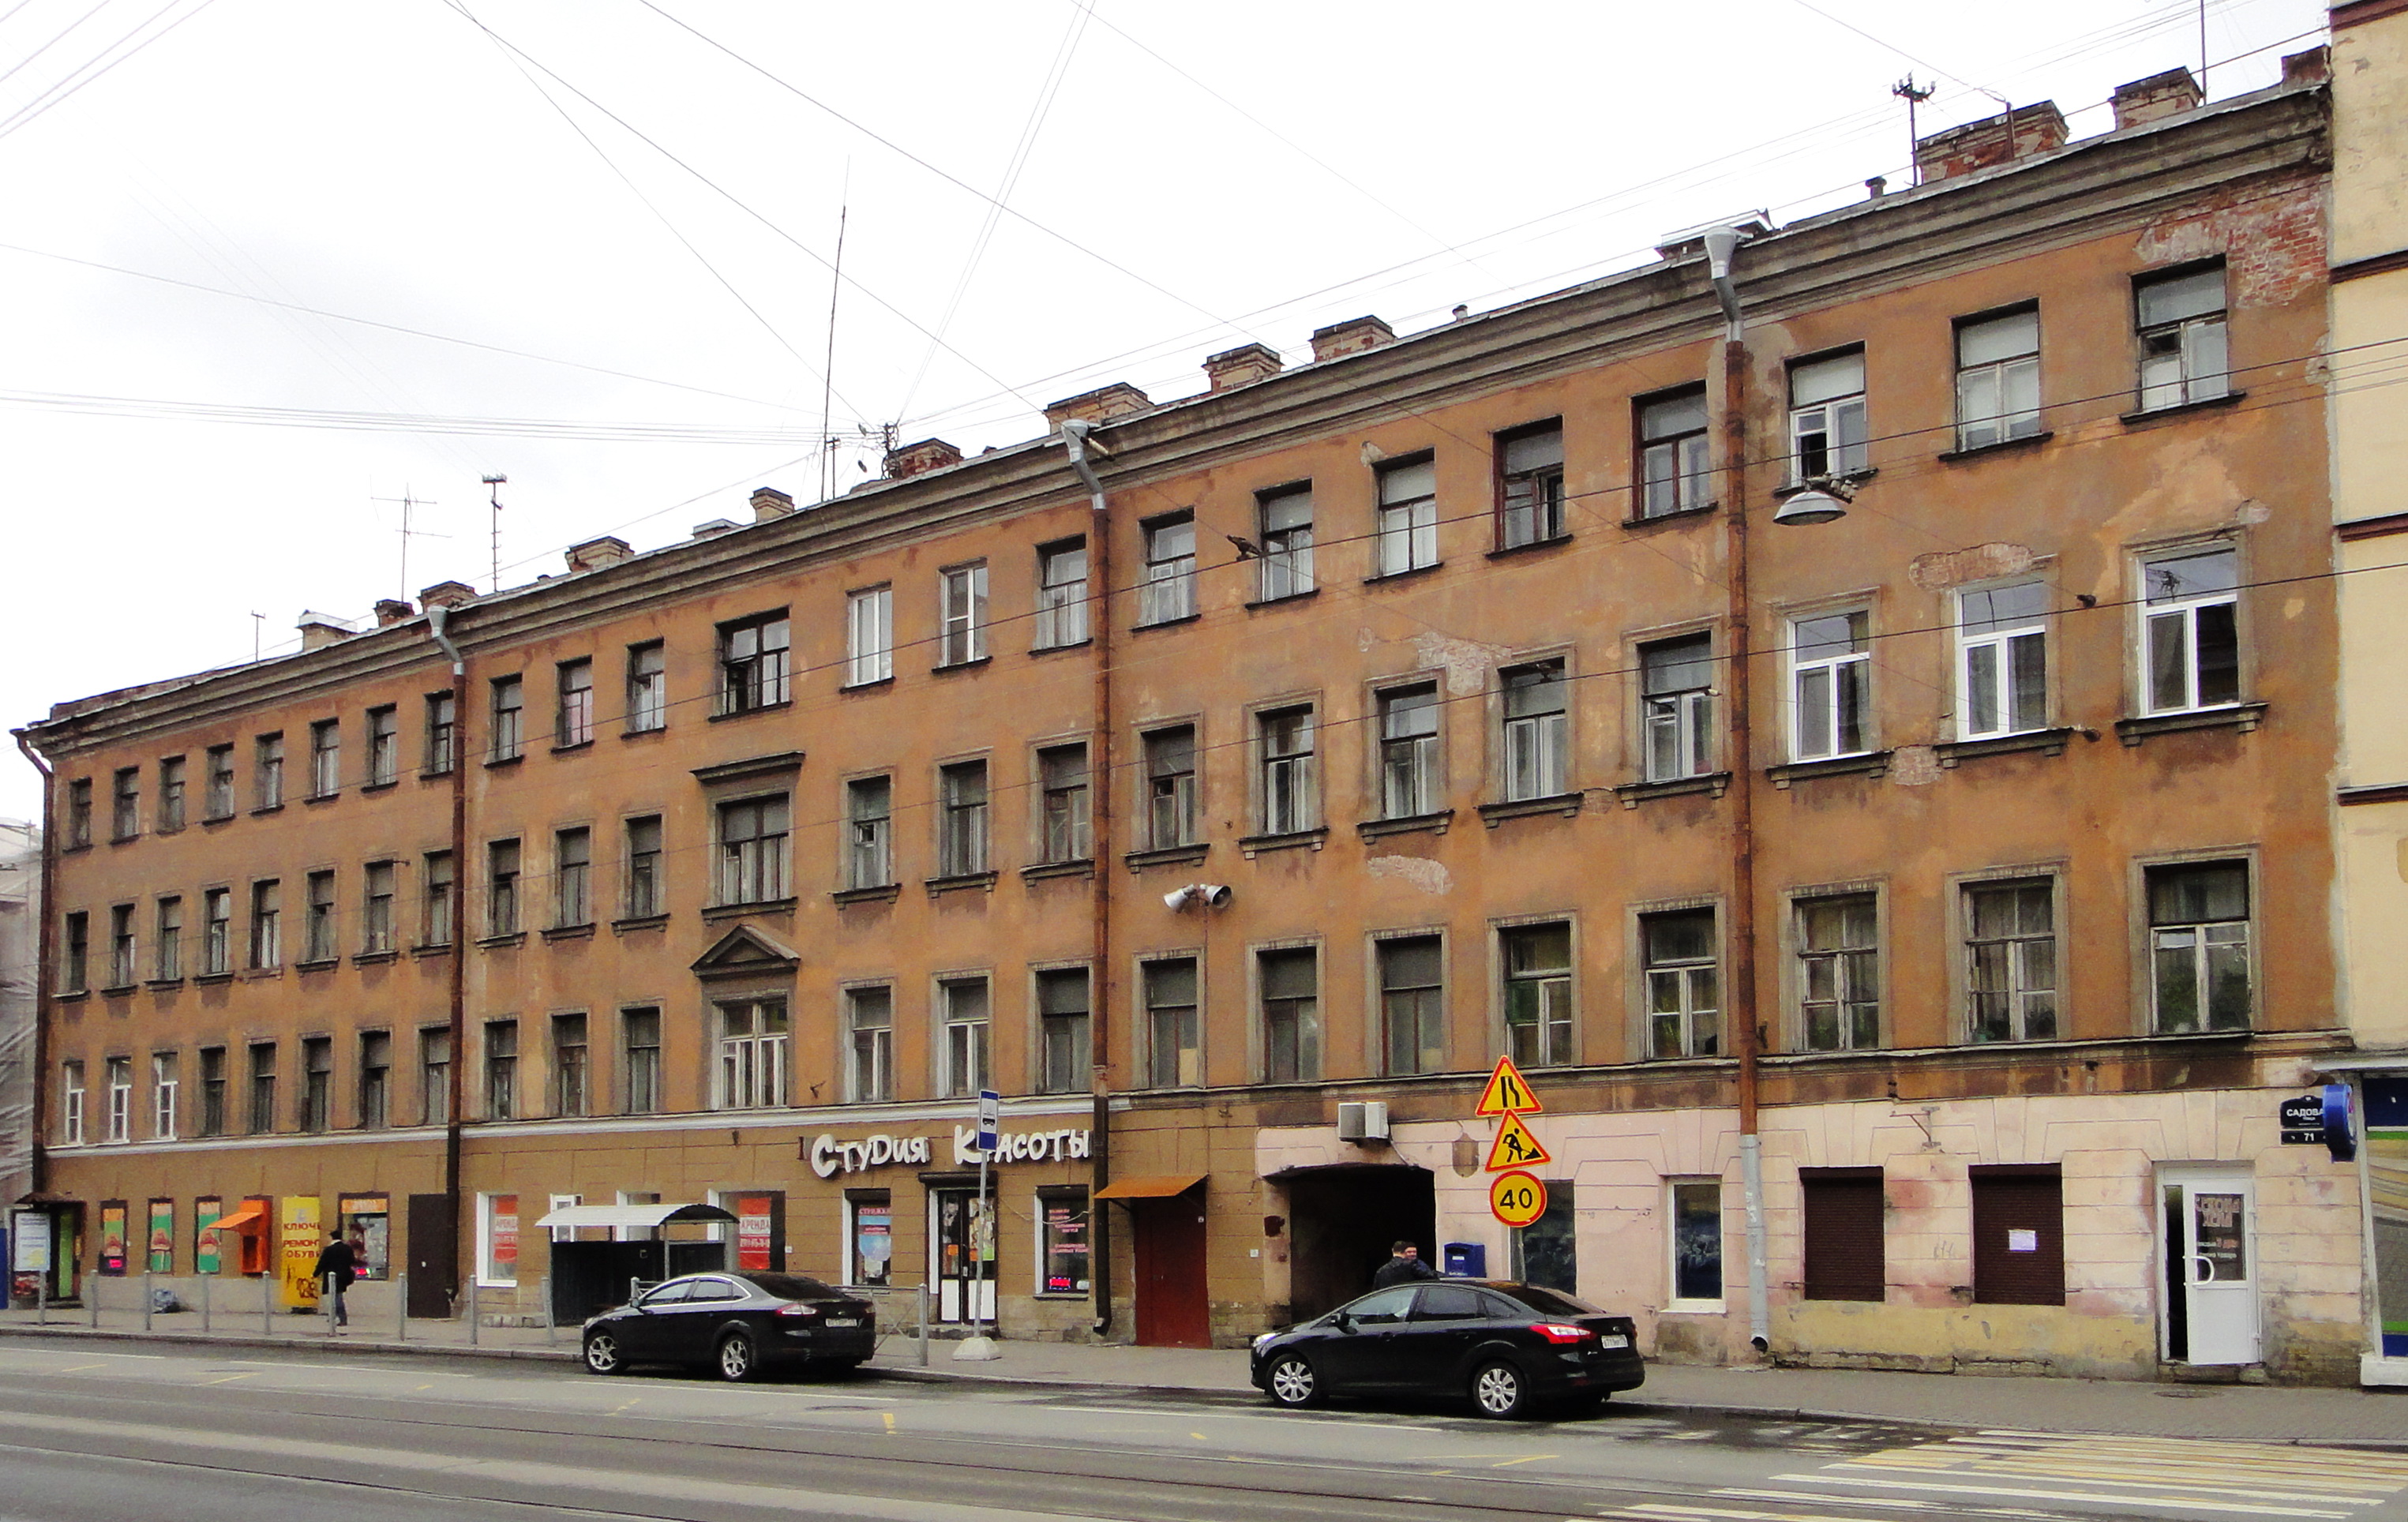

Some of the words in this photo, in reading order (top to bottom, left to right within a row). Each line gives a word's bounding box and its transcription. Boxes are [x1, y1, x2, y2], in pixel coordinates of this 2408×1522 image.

[2286, 1108, 2324, 1117] САДОВА
[2304, 1132, 2315, 1142] 71
[954, 1125, 1090, 1165] КАСОТЫ
[1499, 1187, 1533, 1209] 40
[740, 1218, 771, 1230] АРЕНДА
